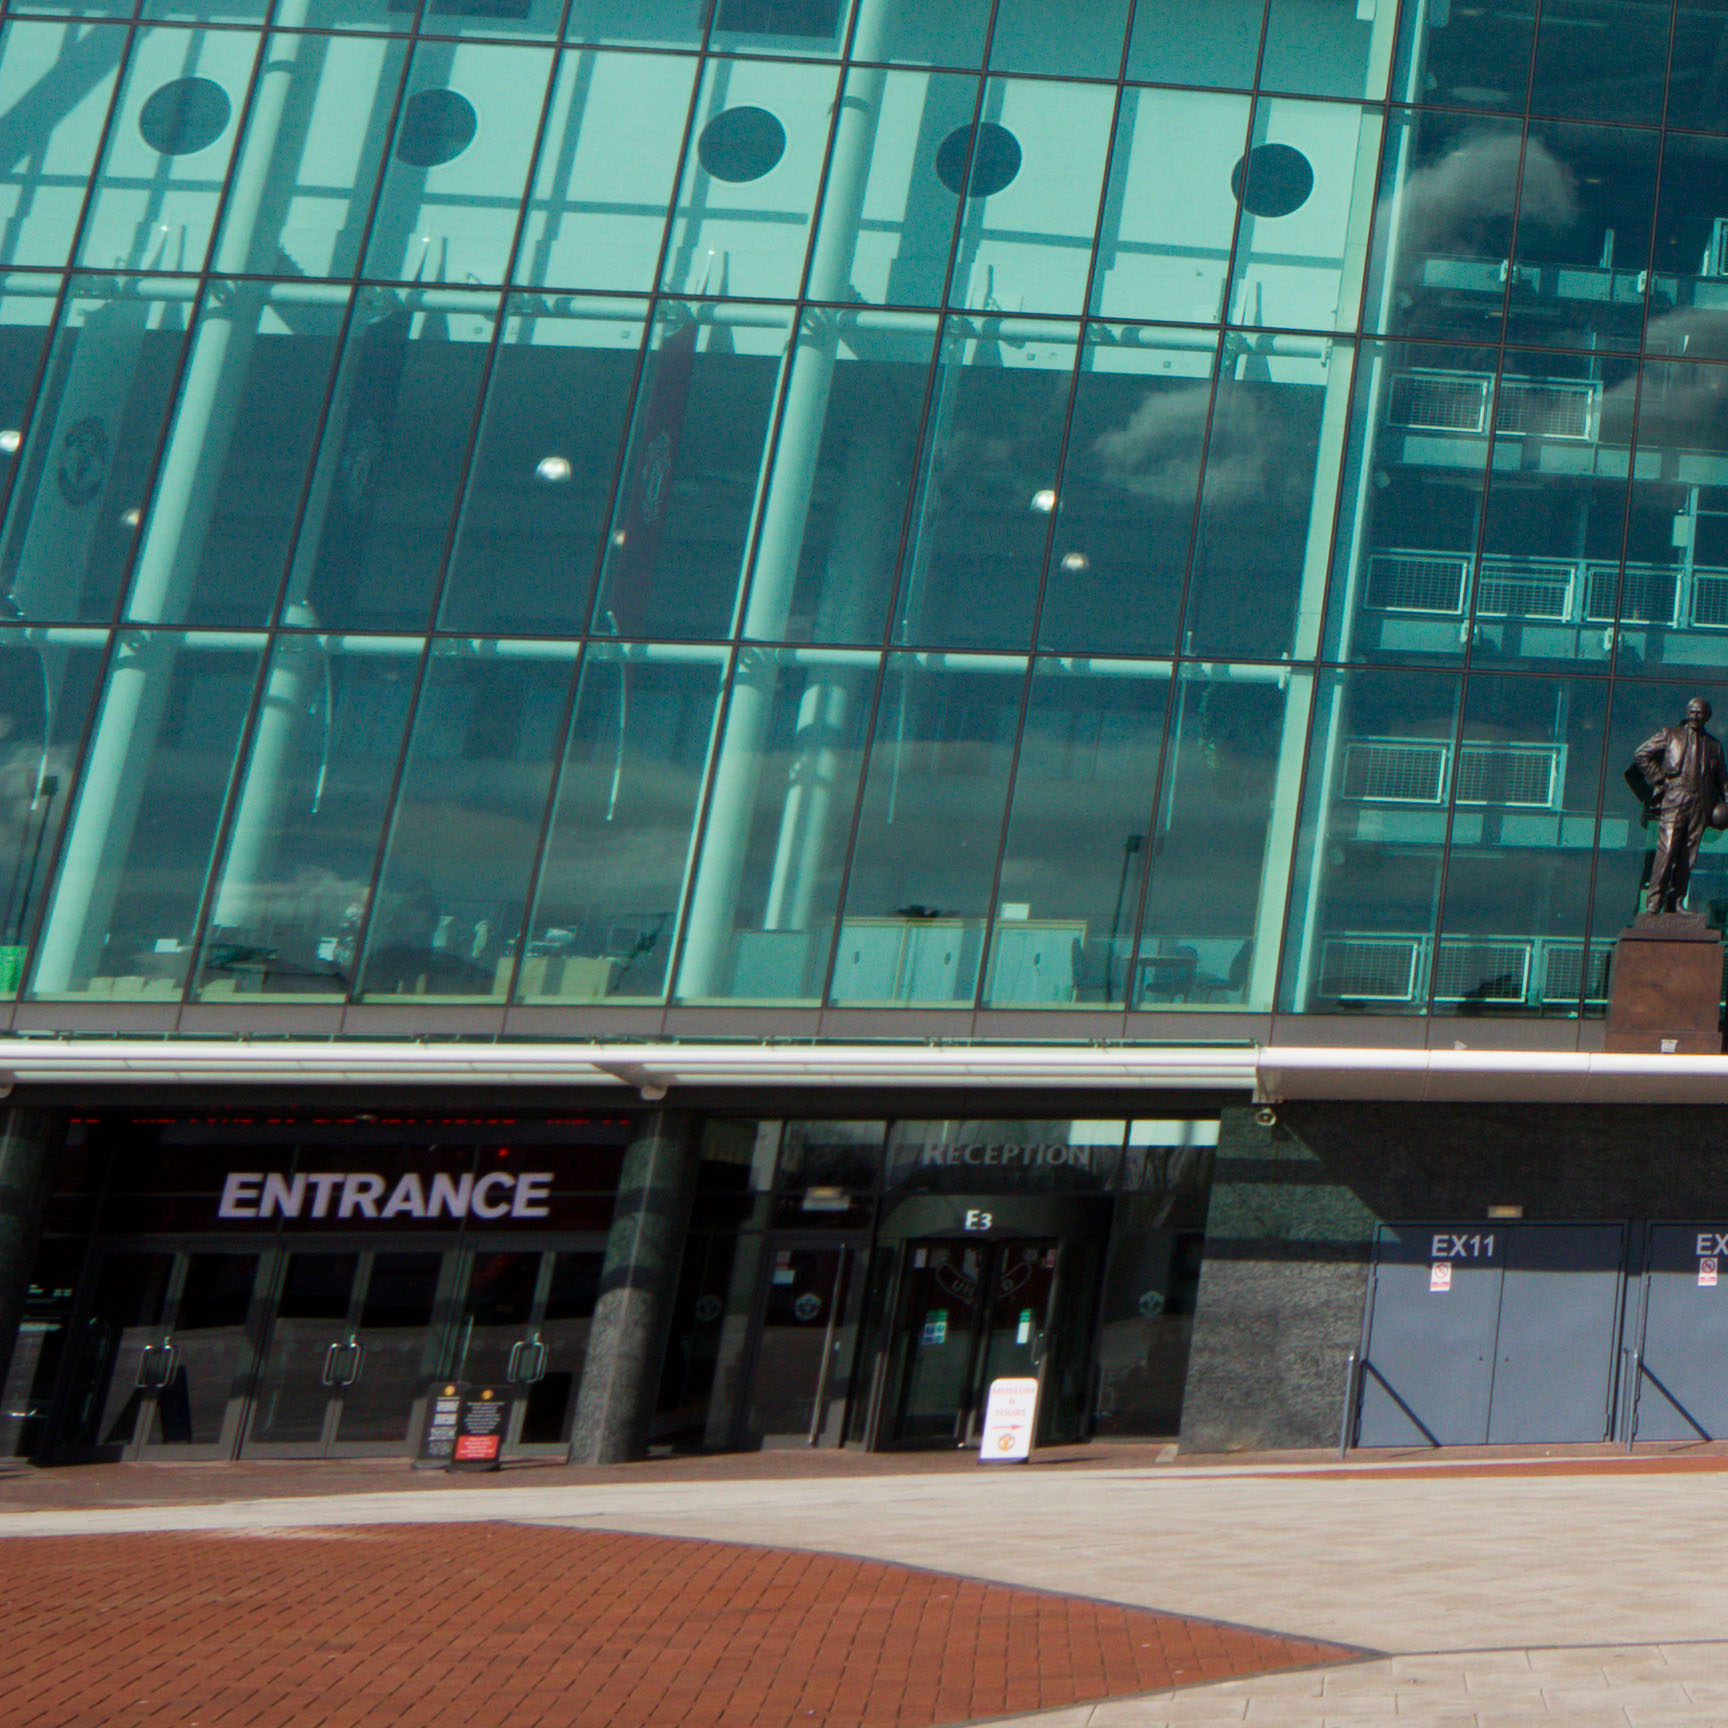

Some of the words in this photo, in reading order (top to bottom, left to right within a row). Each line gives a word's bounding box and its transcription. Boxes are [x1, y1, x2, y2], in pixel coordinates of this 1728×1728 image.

[922, 1142, 1091, 1166] RECEPTION
[218, 1172, 555, 1218] ENTRANCE
[964, 1209, 993, 1231] E3
[1431, 1234, 1495, 1258] EX11
